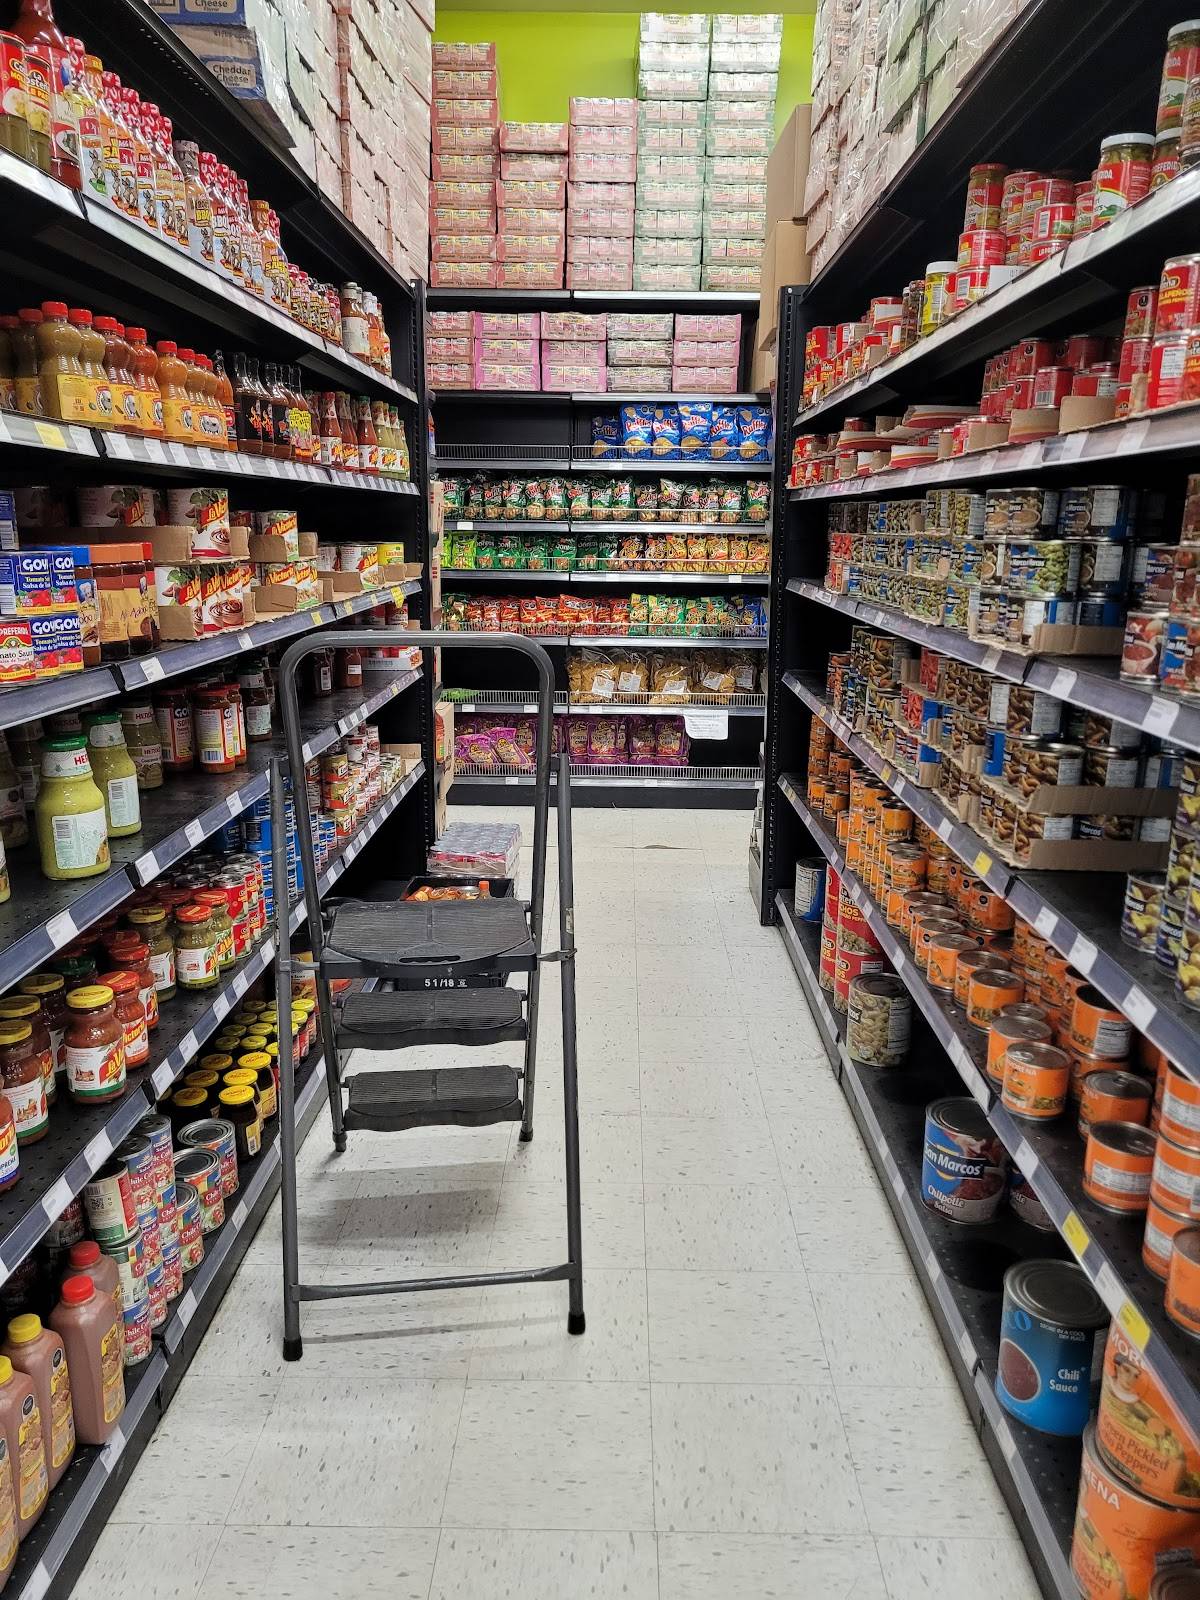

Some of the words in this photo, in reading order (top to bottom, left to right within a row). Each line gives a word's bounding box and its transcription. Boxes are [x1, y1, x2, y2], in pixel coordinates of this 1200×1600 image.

[212, 64, 251, 76] Cheddar
[742, 420, 768, 435] Ruffles
[22, 559, 48, 571] GOY
[55, 618, 79, 631] GOY
[840, 904, 859, 917] CHOS
[925, 1144, 937, 1163] San
[939, 1154, 981, 1176] Marcos
[130, 1176, 143, 1185] hile
[934, 1201, 953, 1216] Salsa
[149, 1291, 161, 1300] hile
[1057, 1368, 1080, 1381] Chili
[1049, 1379, 1079, 1393] Sauce
[1114, 1442, 1160, 1480] Peppers
[1127, 1438, 1169, 1471] Pickled
